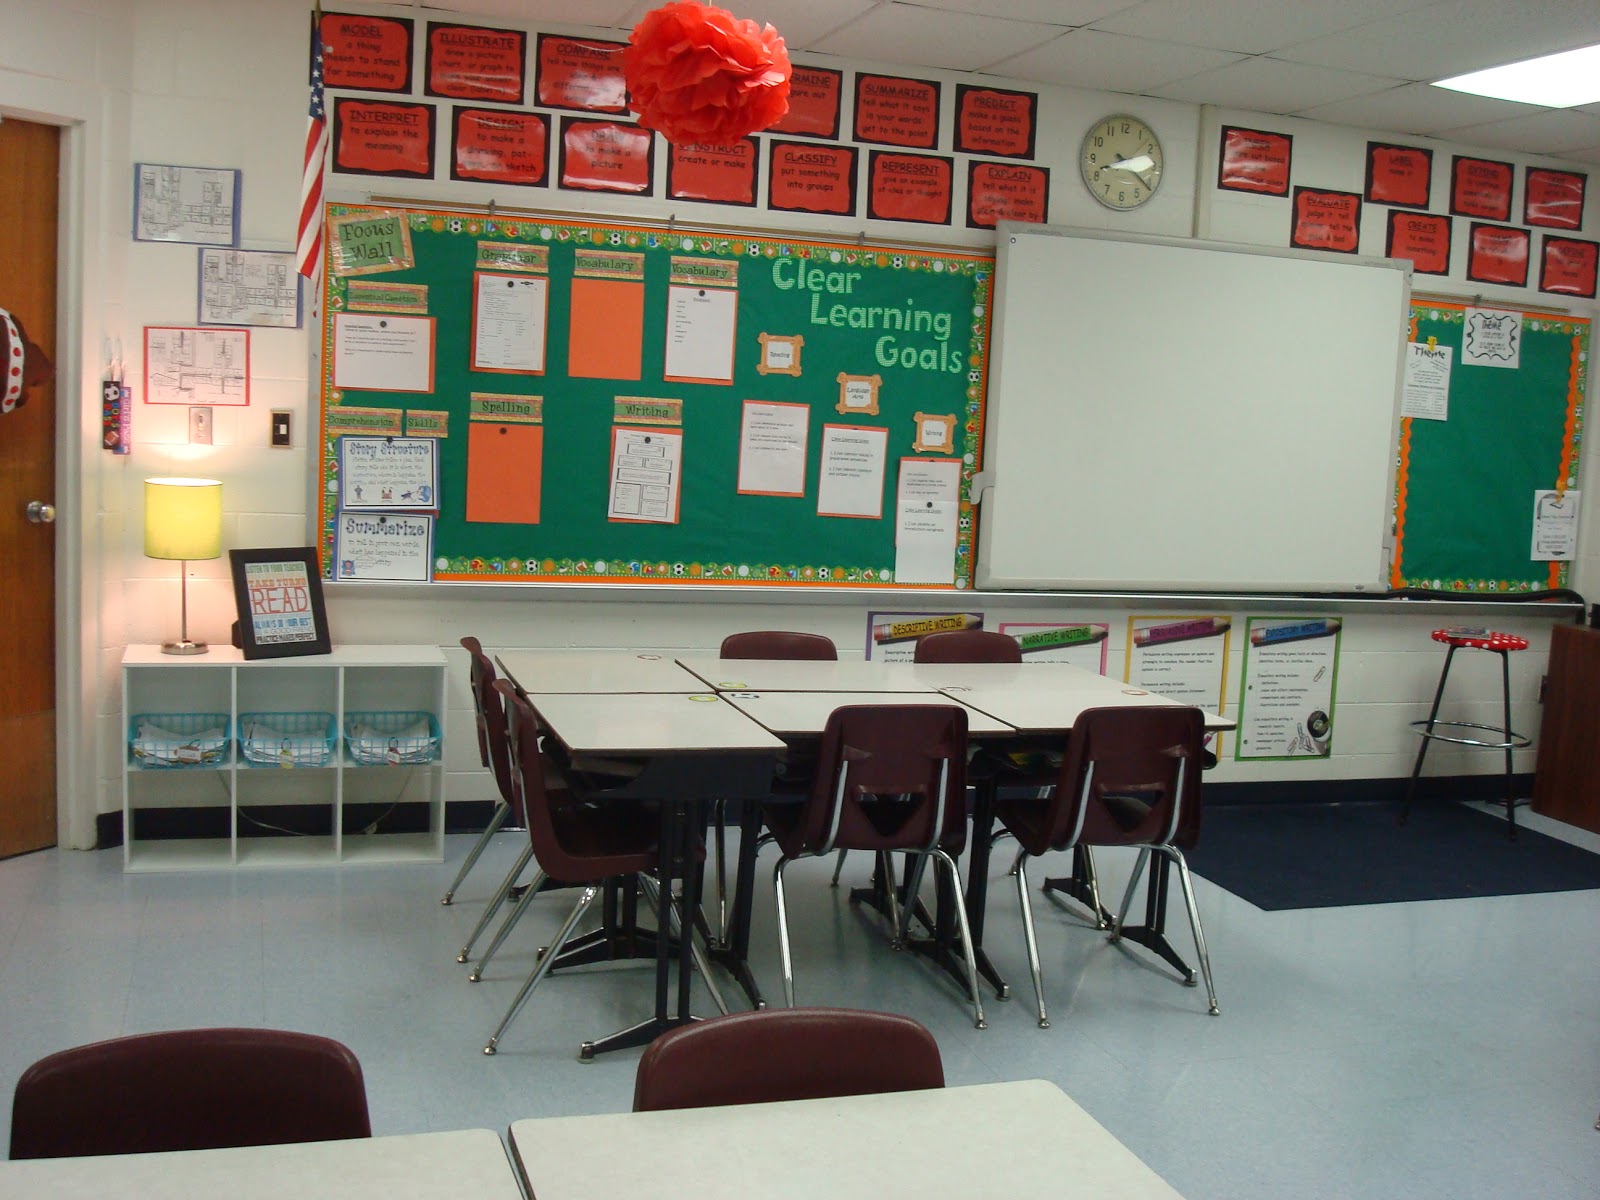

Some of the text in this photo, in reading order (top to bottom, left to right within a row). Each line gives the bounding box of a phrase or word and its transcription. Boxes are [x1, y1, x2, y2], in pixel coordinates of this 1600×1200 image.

[340, 24, 383, 38] MODEL
[440, 33, 514, 48] ILLUSTRATE
[346, 70, 394, 82] something
[790, 72, 831, 87] ERMINE
[865, 84, 929, 99] SUMMARIZE
[880, 100, 899, 108] what
[974, 96, 1017, 110] PREDICT
[350, 110, 419, 123] INTERPRET
[477, 116, 525, 130] DESIGN
[877, 113, 895, 121] your
[364, 129, 398, 138] explain
[403, 130, 418, 138] the
[862, 126, 875, 134] get
[891, 128, 905, 136] the
[908, 130, 928, 138] point
[1107, 125, 1114, 136] 11
[1121, 123, 1130, 134] 12
[477, 133, 486, 141] to
[491, 134, 514, 143] make
[1094, 136, 1103, 147] 10
[364, 142, 404, 154] meaning
[599, 147, 621, 155] make
[1147, 143, 1153, 154] 2
[678, 156, 707, 164] create
[724, 161, 745, 169] make
[784, 152, 838, 165] CLASSIFY
[1090, 153, 1096, 163] 9
[506, 163, 536, 172] sketch
[591, 160, 623, 170] picture
[882, 161, 940, 175] REPRESENT
[781, 168, 840, 181] put something
[988, 167, 1032, 181] EXPLAIN
[1094, 171, 1100, 181] 8
[786, 181, 833, 192] into groups
[1104, 184, 1110, 195] 7
[1134, 188, 1140, 198] 5
[1119, 191, 1125, 202] 6
[1306, 196, 1351, 209] EVALUATE
[341, 222, 394, 241] Focus
[1407, 221, 1438, 233] CREATE
[349, 241, 394, 260] Wall
[575, 257, 635, 272] Vocabulary
[671, 263, 728, 279] Vocabulary
[772, 257, 861, 294] Clear
[811, 292, 951, 341] Learning
[875, 335, 962, 374] Goals
[1414, 345, 1446, 360] Theme
[482, 401, 531, 415] Spelling
[625, 405, 670, 419] Writing
[407, 416, 438, 428] Skills
[350, 441, 429, 459] Story Structure
[346, 518, 425, 536] Summarize
[248, 577, 307, 588] TAKE TURNS
[250, 586, 307, 614] READ
[893, 616, 962, 636] DESCRIPTIVE WRITING
[256, 634, 279, 643] PRACTICE
[295, 632, 314, 641] PERFECT
[1022, 627, 1089, 646] NARRATIVE WRITING
